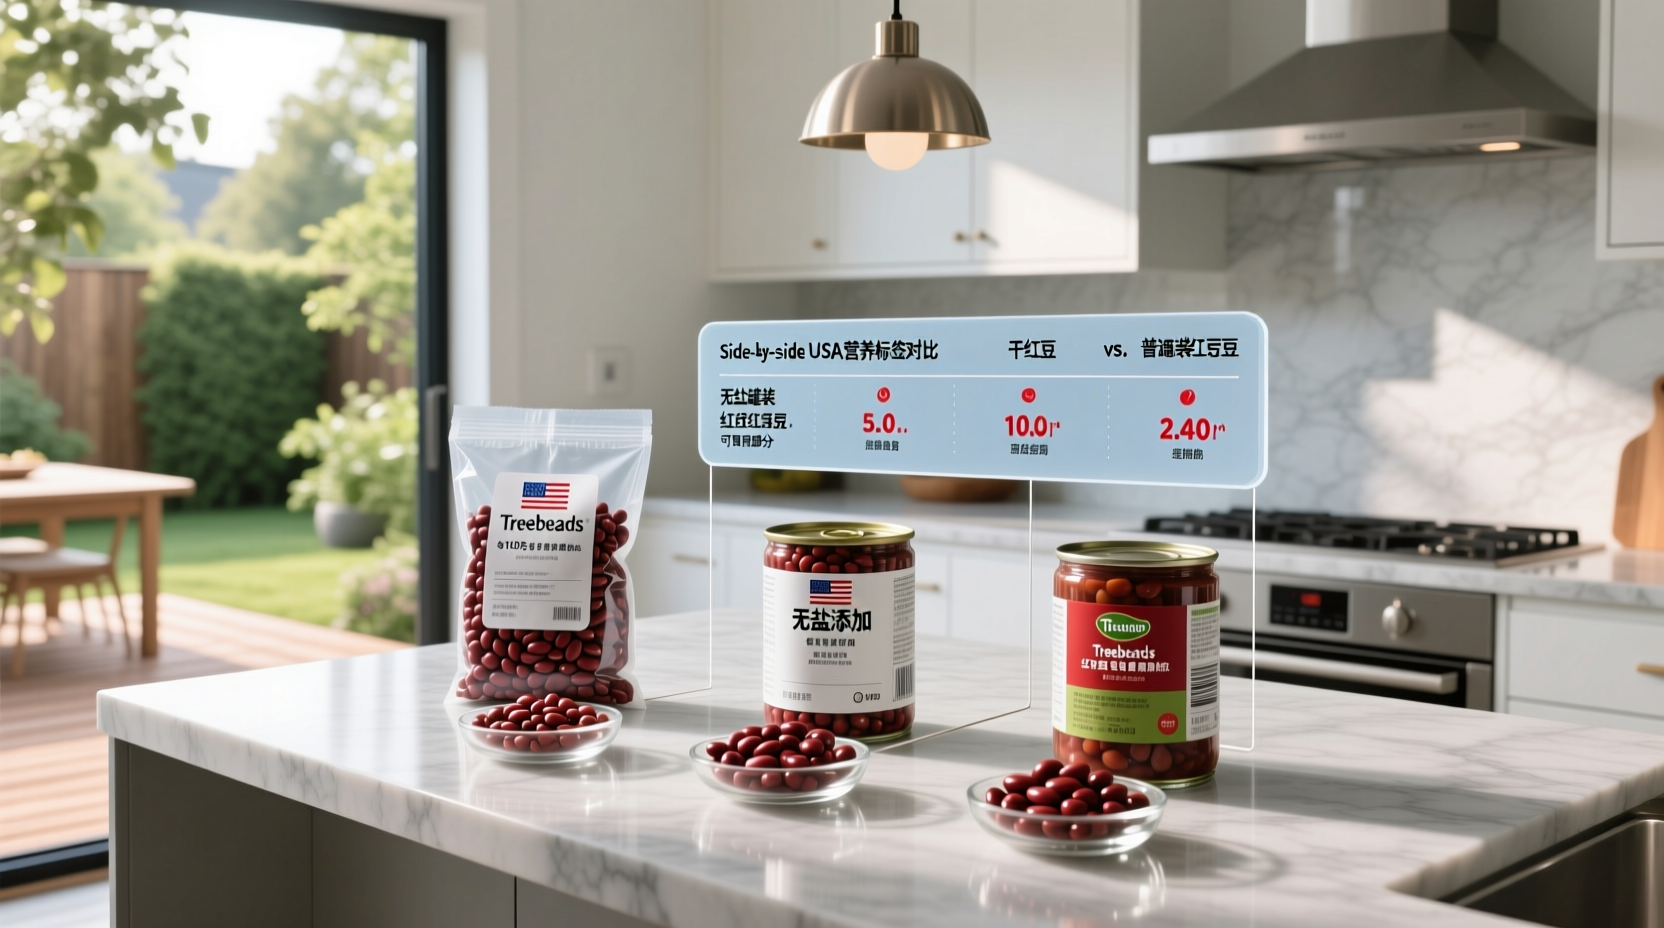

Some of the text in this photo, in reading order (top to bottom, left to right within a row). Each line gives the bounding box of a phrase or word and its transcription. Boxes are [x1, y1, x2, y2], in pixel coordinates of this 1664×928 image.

[501, 514, 583, 533] Treebeads
[792, 608, 872, 632] 无盐添加
